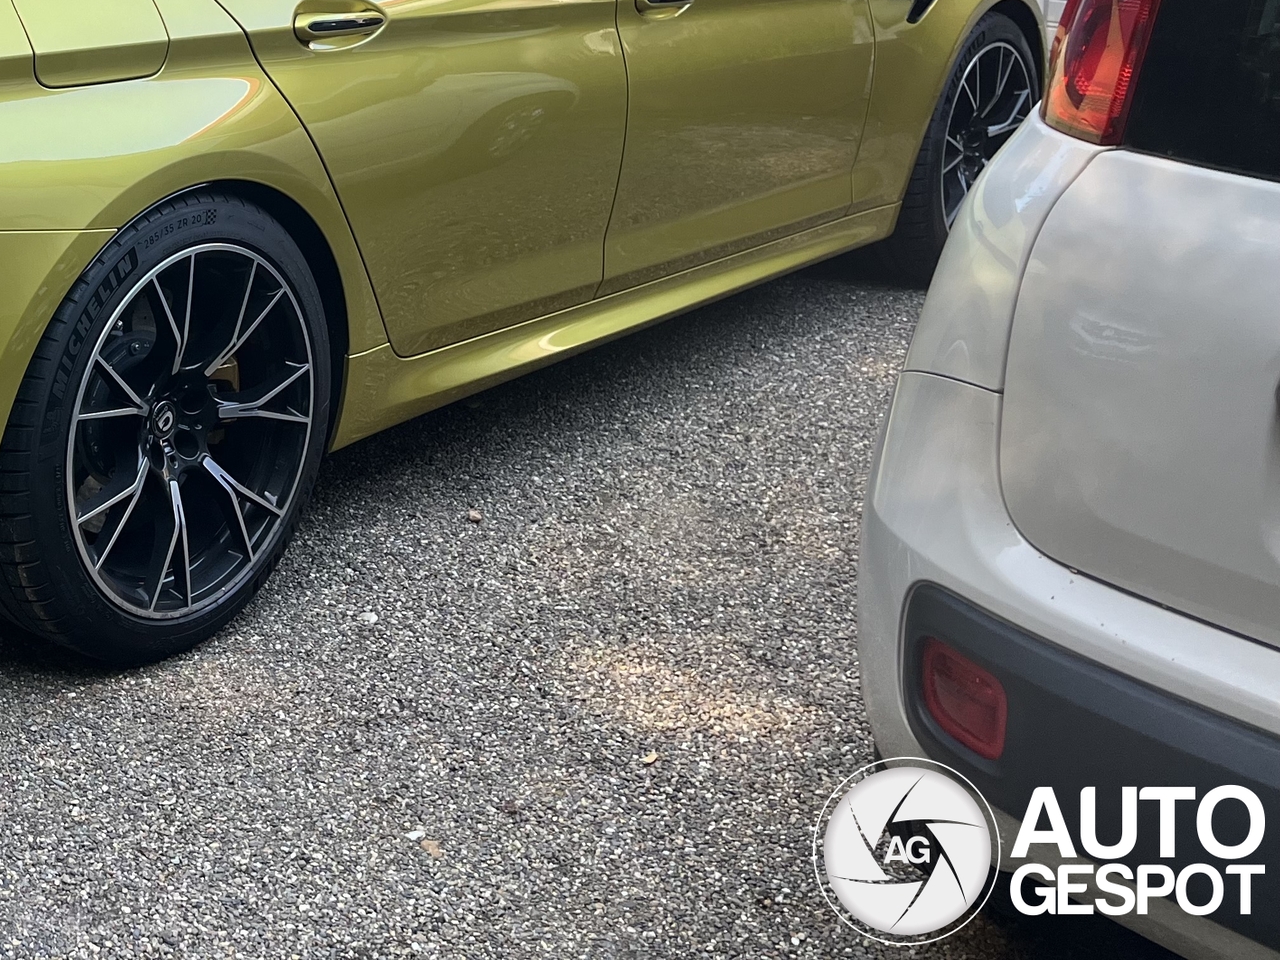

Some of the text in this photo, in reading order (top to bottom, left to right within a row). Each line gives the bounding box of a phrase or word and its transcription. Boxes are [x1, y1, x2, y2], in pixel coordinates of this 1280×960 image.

[144, 223, 175, 249] 285/35
[177, 217, 188, 230] ZR
[191, 214, 202, 225] 20
[51, 248, 135, 401] MICHELIN
